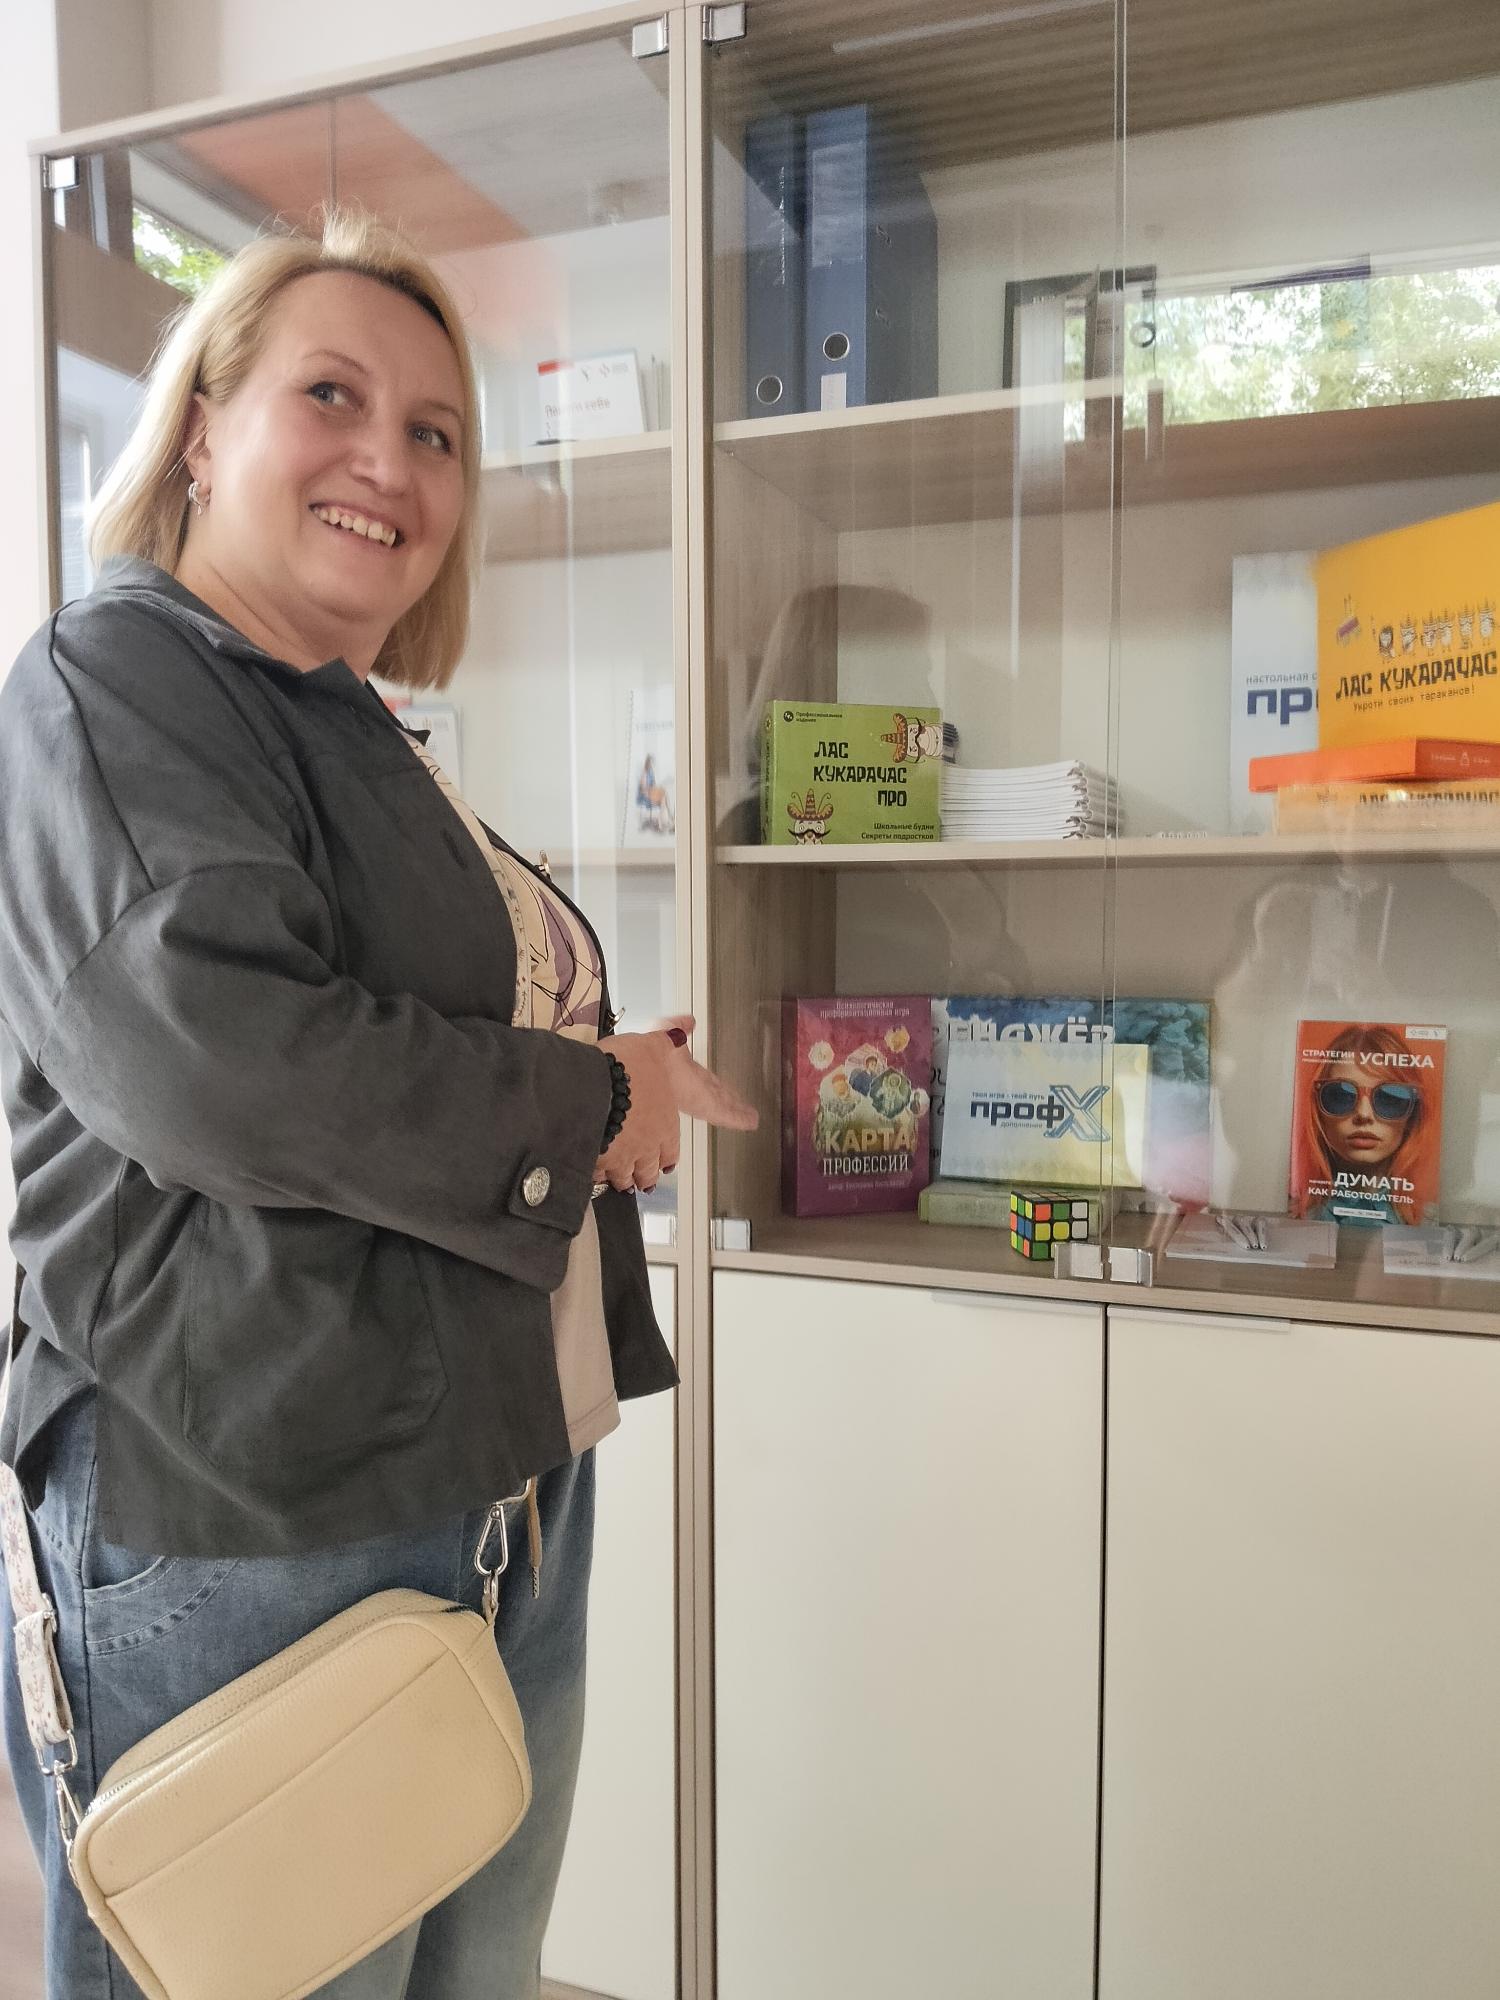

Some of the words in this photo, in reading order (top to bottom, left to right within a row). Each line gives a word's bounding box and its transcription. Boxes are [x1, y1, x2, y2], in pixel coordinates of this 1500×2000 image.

[1246, 672, 1309, 684] настольная
[1335, 672, 1373, 701] ЛАС
[1380, 651, 1498, 693] КУКАРАЧАС
[1247, 687, 1319, 725] пр
[1353, 700, 1383, 713] Укроти
[1388, 696, 1414, 706] своих
[1420, 682, 1475, 702] тараканов!
[813, 741, 849, 759] ЛАС
[813, 765, 908, 784] КУКАРАЧАС
[877, 789, 908, 807] ПРО
[873, 822, 913, 830] Школьные
[913, 822, 935, 831] будни
[861, 832, 892, 841] Секреты
[1302, 1049, 1355, 1059] СТРАТЕГИИ
[1359, 1051, 1435, 1069] УСПЕХА
[825, 1128, 912, 1154] КАРТА
[823, 1152, 909, 1177] ПРОФЕССИЙ
[1334, 1171, 1415, 1192] ДУМАТЬ
[1308, 1186, 1328, 1196] КАК
[1331, 1189, 1414, 1204] РАБОТОДАТЕЛЬ
